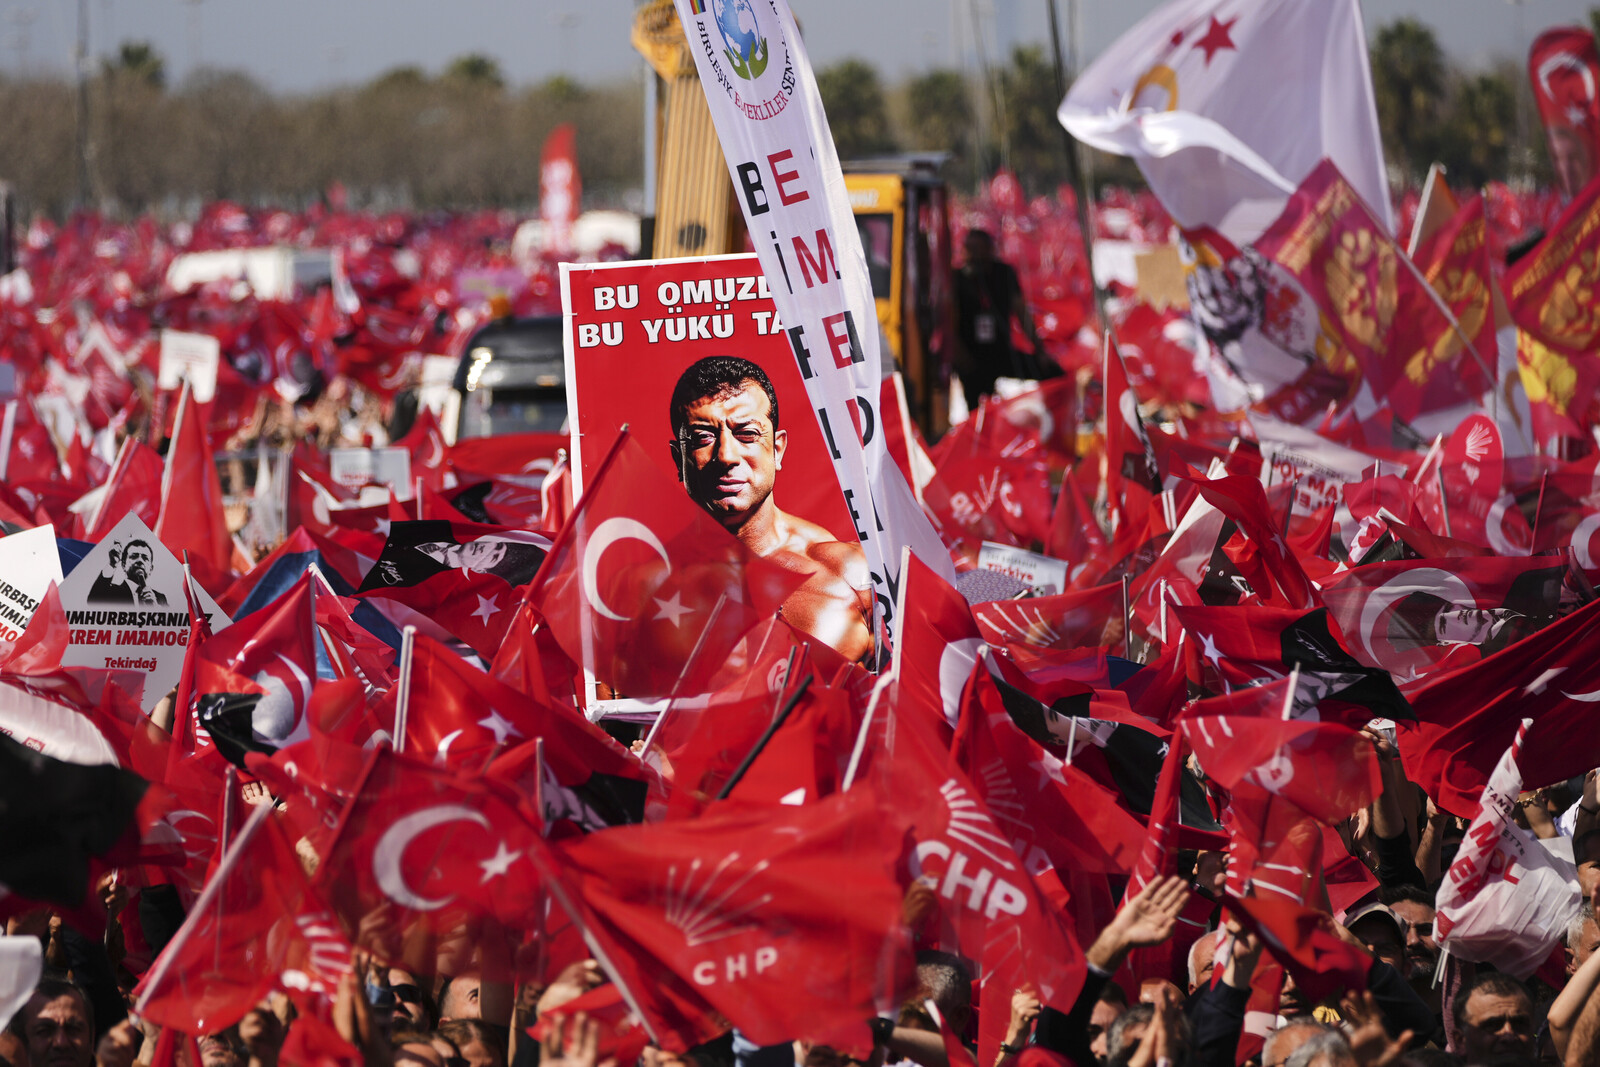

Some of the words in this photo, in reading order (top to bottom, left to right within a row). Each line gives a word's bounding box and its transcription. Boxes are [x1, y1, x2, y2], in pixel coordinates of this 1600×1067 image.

[593, 284, 640, 311] BU
[578, 321, 624, 348] BU
[640, 303, 735, 344] YÜKÜ
[56, 629, 112, 645] KREM
[116, 629, 191, 647] İMAMOĞ
[104, 657, 157, 672] Tekirdağ
[908, 840, 1027, 920] CHP
[692, 946, 779, 986] CHP
